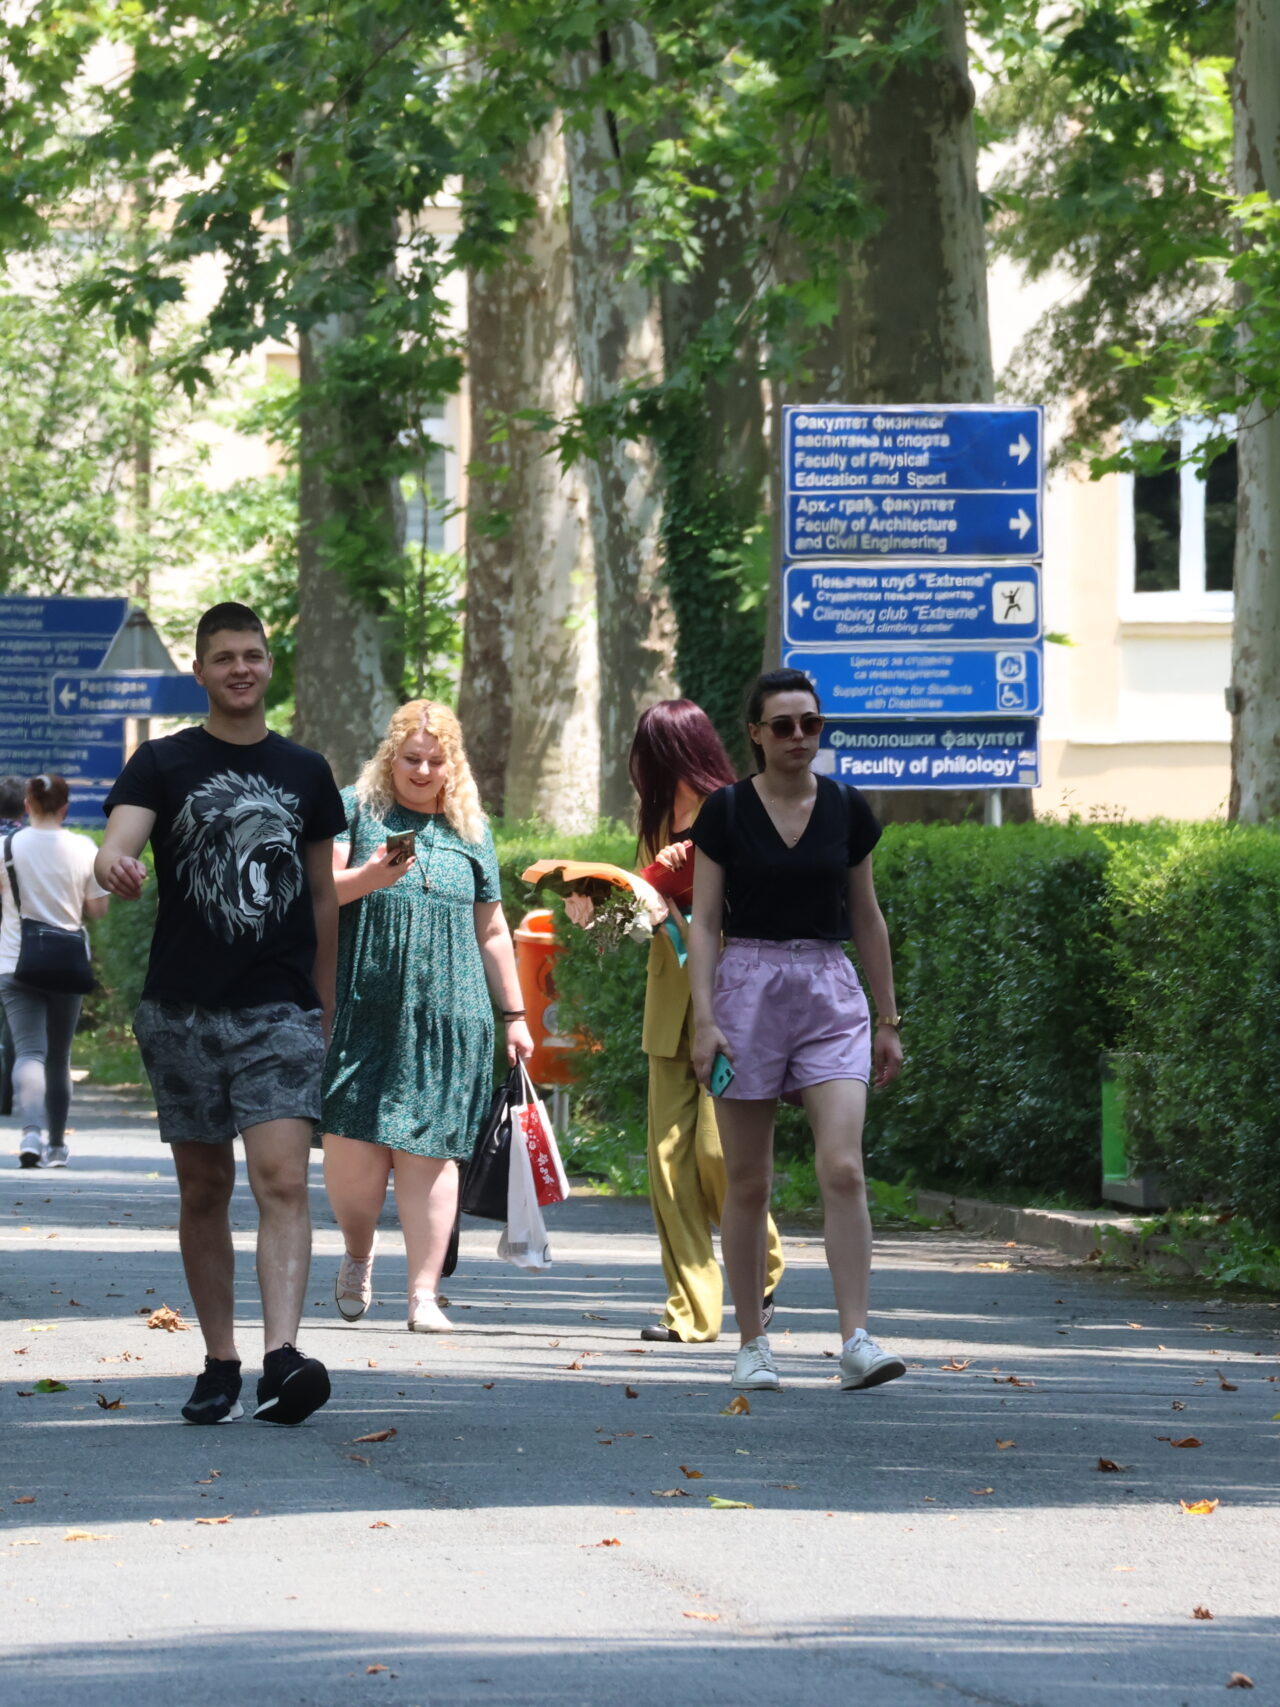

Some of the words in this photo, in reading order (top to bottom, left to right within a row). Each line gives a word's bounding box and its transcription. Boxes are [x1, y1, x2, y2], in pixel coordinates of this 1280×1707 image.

[795, 415, 868, 432] Факултет
[872, 415, 946, 432] физичког
[795, 434, 880, 448] васпитања
[883, 435, 893, 448] и
[896, 434, 951, 450] спорта
[795, 451, 848, 471] Faculty
[851, 451, 867, 468] of
[869, 451, 930, 470] Physical
[795, 472, 869, 487] Education
[872, 472, 900, 486] and
[907, 471, 947, 489] Sport
[881, 496, 957, 516] факултет
[795, 517, 849, 535] Faculty
[851, 517, 867, 532] of
[869, 516, 958, 532] Architecture
[795, 535, 823, 550] and
[825, 535, 858, 550] Civil
[861, 534, 948, 553] Engineering
[812, 574, 877, 589] Пењачки
[881, 573, 917, 591] клуб
[816, 591, 881, 604] Студентски
[884, 592, 933, 602] пењачки
[934, 591, 975, 602] центар
[812, 605, 876, 624] Climbing
[878, 606, 908, 620] club
[835, 623, 875, 634] Student
[876, 623, 919, 635] climbing
[920, 623, 954, 633] center
[850, 656, 889, 668] Центар
[891, 657, 903, 666] за
[833, 685, 873, 698] Support
[874, 685, 909, 696] Center
[910, 685, 925, 696] for
[927, 683, 973, 696] Students
[80, 696, 153, 711] Restaurant
[864, 698, 886, 710] with
[888, 698, 944, 710] Disabilities
[829, 730, 935, 748] Филолошки
[940, 729, 1025, 750] факултет
[840, 756, 905, 778] Faculty
[909, 756, 929, 774] of
[931, 756, 1017, 778] philology
